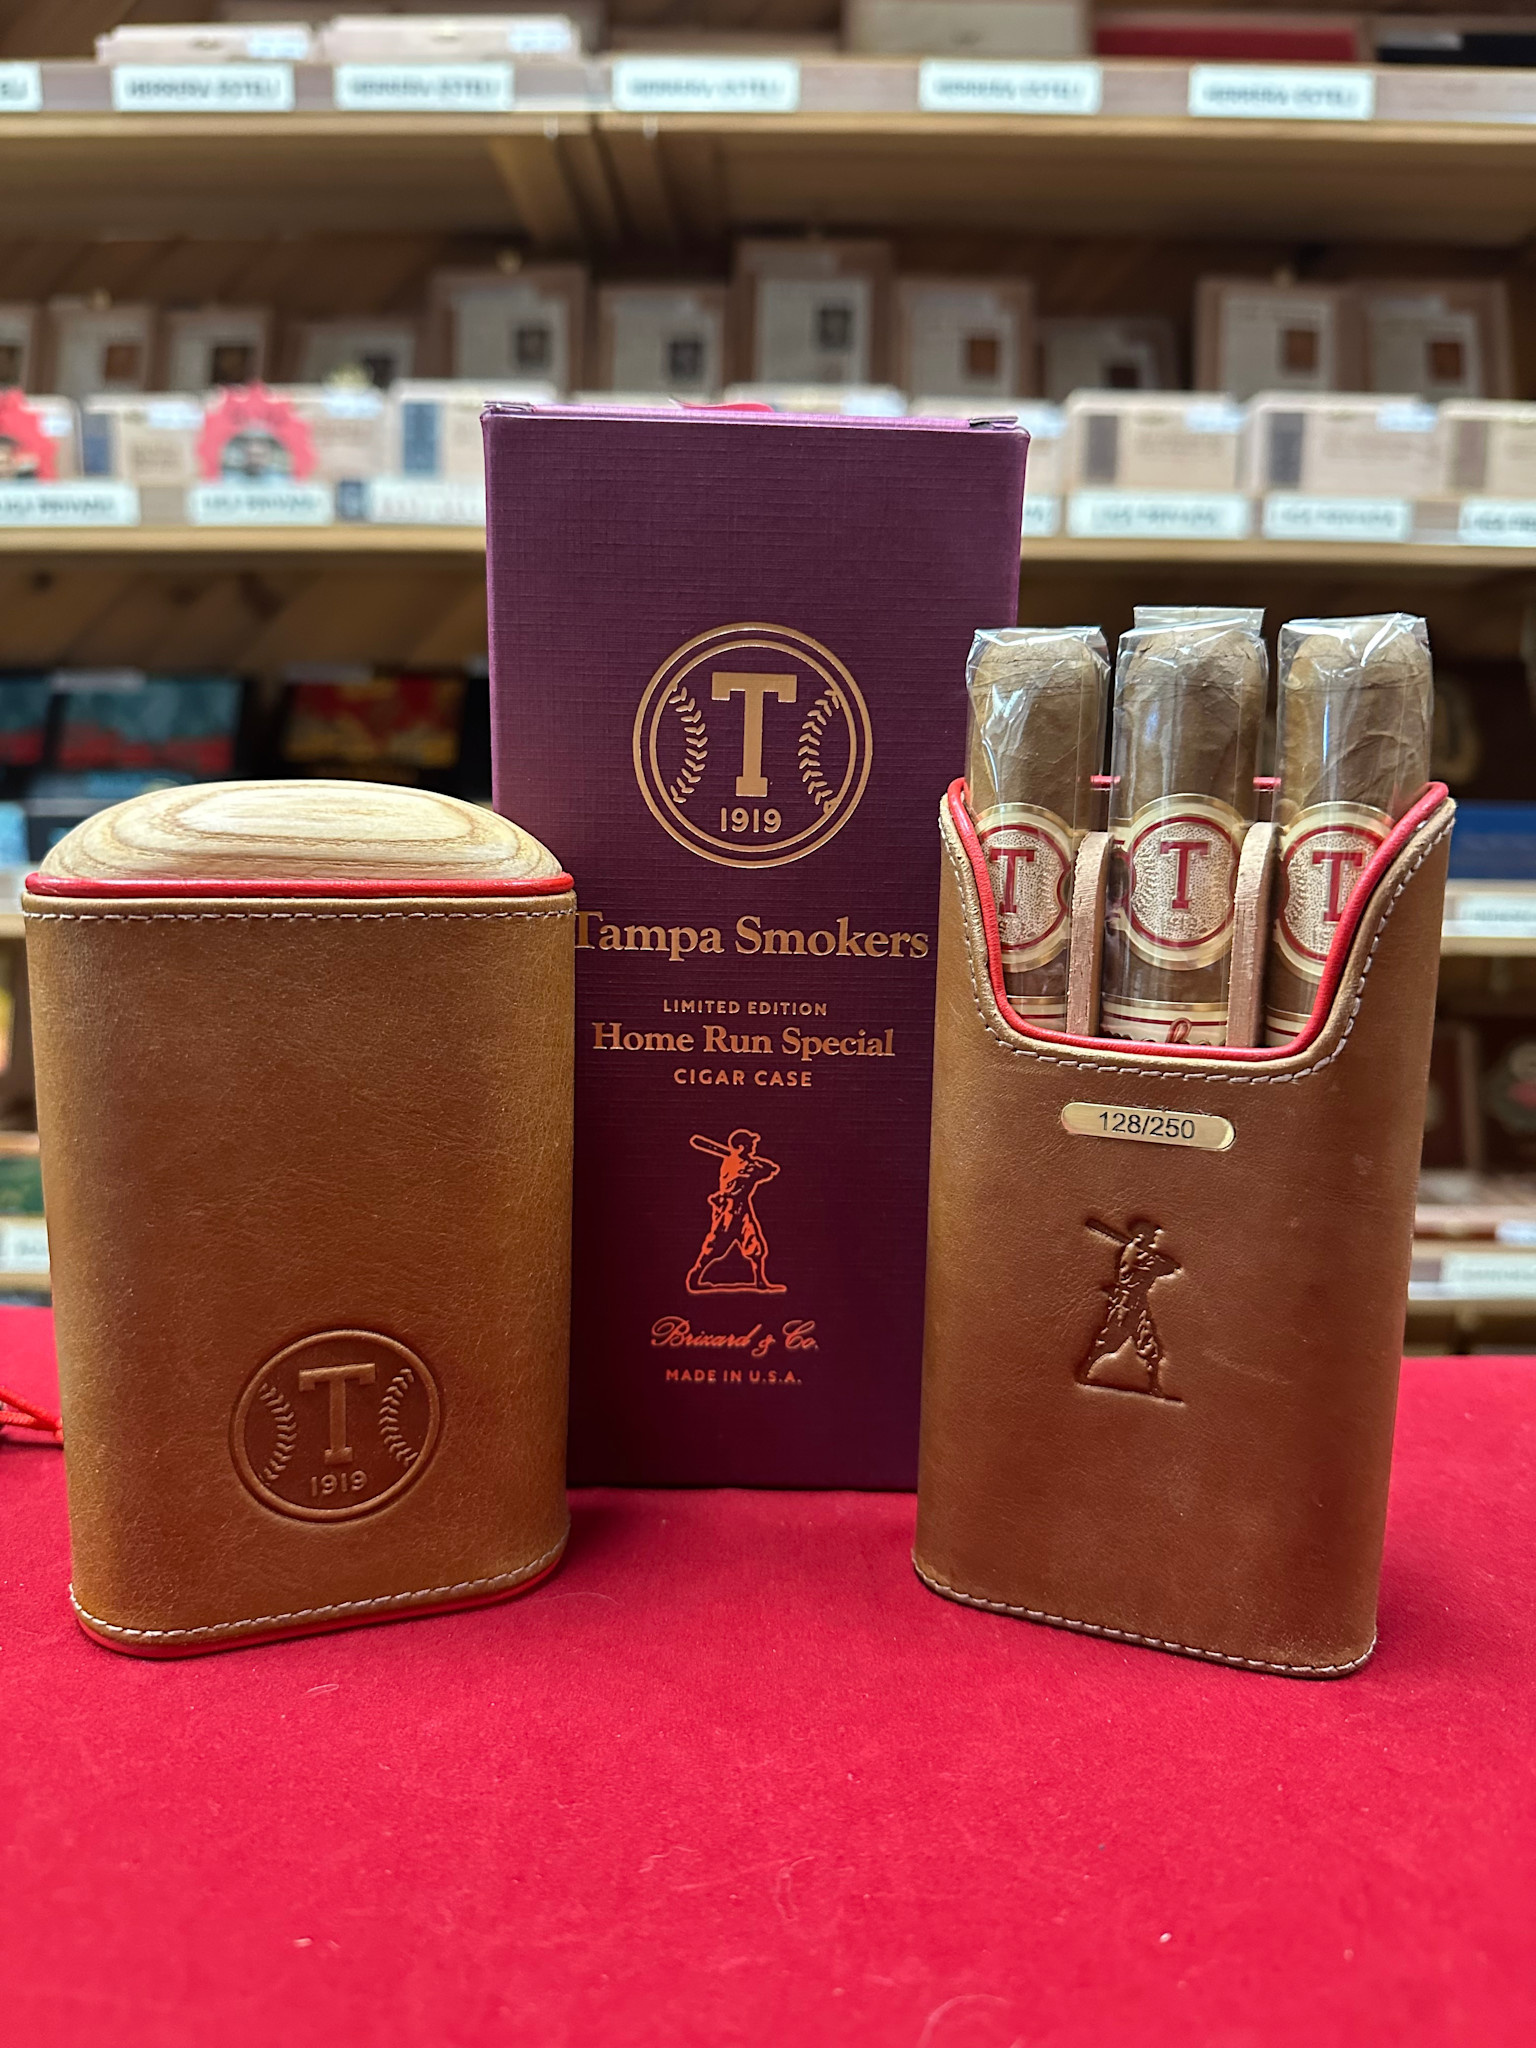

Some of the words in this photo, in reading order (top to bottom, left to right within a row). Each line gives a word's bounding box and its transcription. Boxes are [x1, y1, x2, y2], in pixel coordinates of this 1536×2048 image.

[711, 672, 798, 798] T
[720, 807, 782, 834] 1919
[989, 848, 1036, 914] T
[1159, 841, 1210, 910] T
[575, 910, 725, 962] Tampa
[734, 915, 930, 960] Smokers
[663, 999, 740, 1015] LIMITED
[748, 1001, 828, 1017] EDITION
[591, 1022, 695, 1053] Home
[702, 1024, 774, 1055] Run
[781, 1026, 896, 1061] Special
[673, 1068, 745, 1087] CIGAR
[754, 1070, 813, 1088] CASE
[1099, 1111, 1195, 1139] 128/250
[650, 1315, 762, 1348] Brizard
[782, 1319, 819, 1350] Co.
[665, 1369, 717, 1383] MADE
[723, 1370, 742, 1383] IN
[748, 1370, 802, 1385] U.S.A.
[299, 1363, 376, 1465] T
[310, 1470, 368, 1498] 1919
